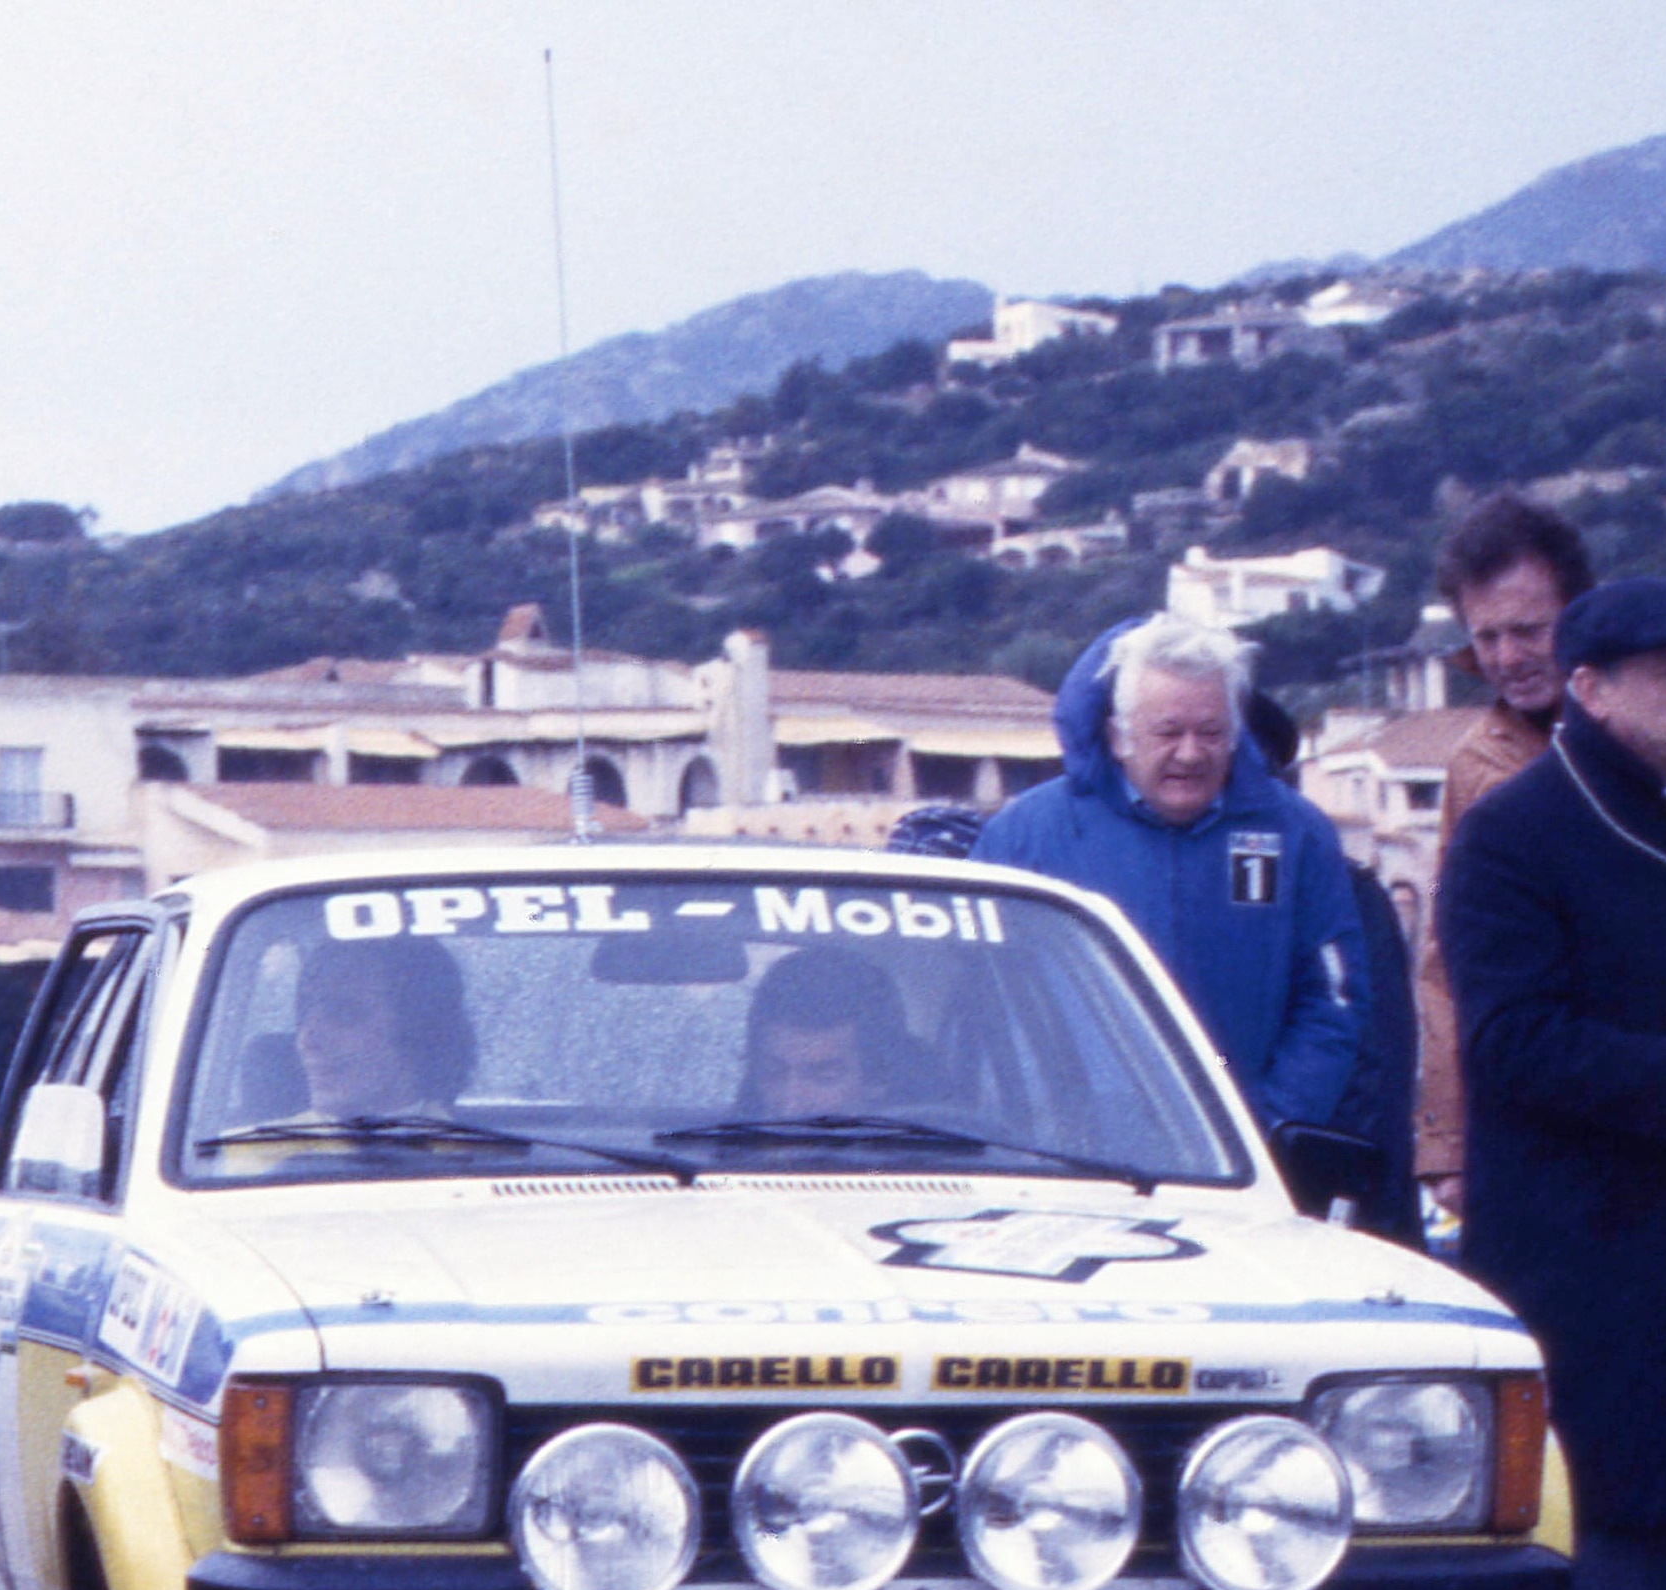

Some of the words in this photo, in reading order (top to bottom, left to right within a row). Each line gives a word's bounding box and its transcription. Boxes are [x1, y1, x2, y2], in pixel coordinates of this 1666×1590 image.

[1242, 857, 1263, 901] 1
[325, 885, 650, 940] OPEL
[753, 886, 1004, 943] Mobil
[636, 1356, 896, 1388] CARELLO
[936, 1357, 1184, 1389] CARELLO
